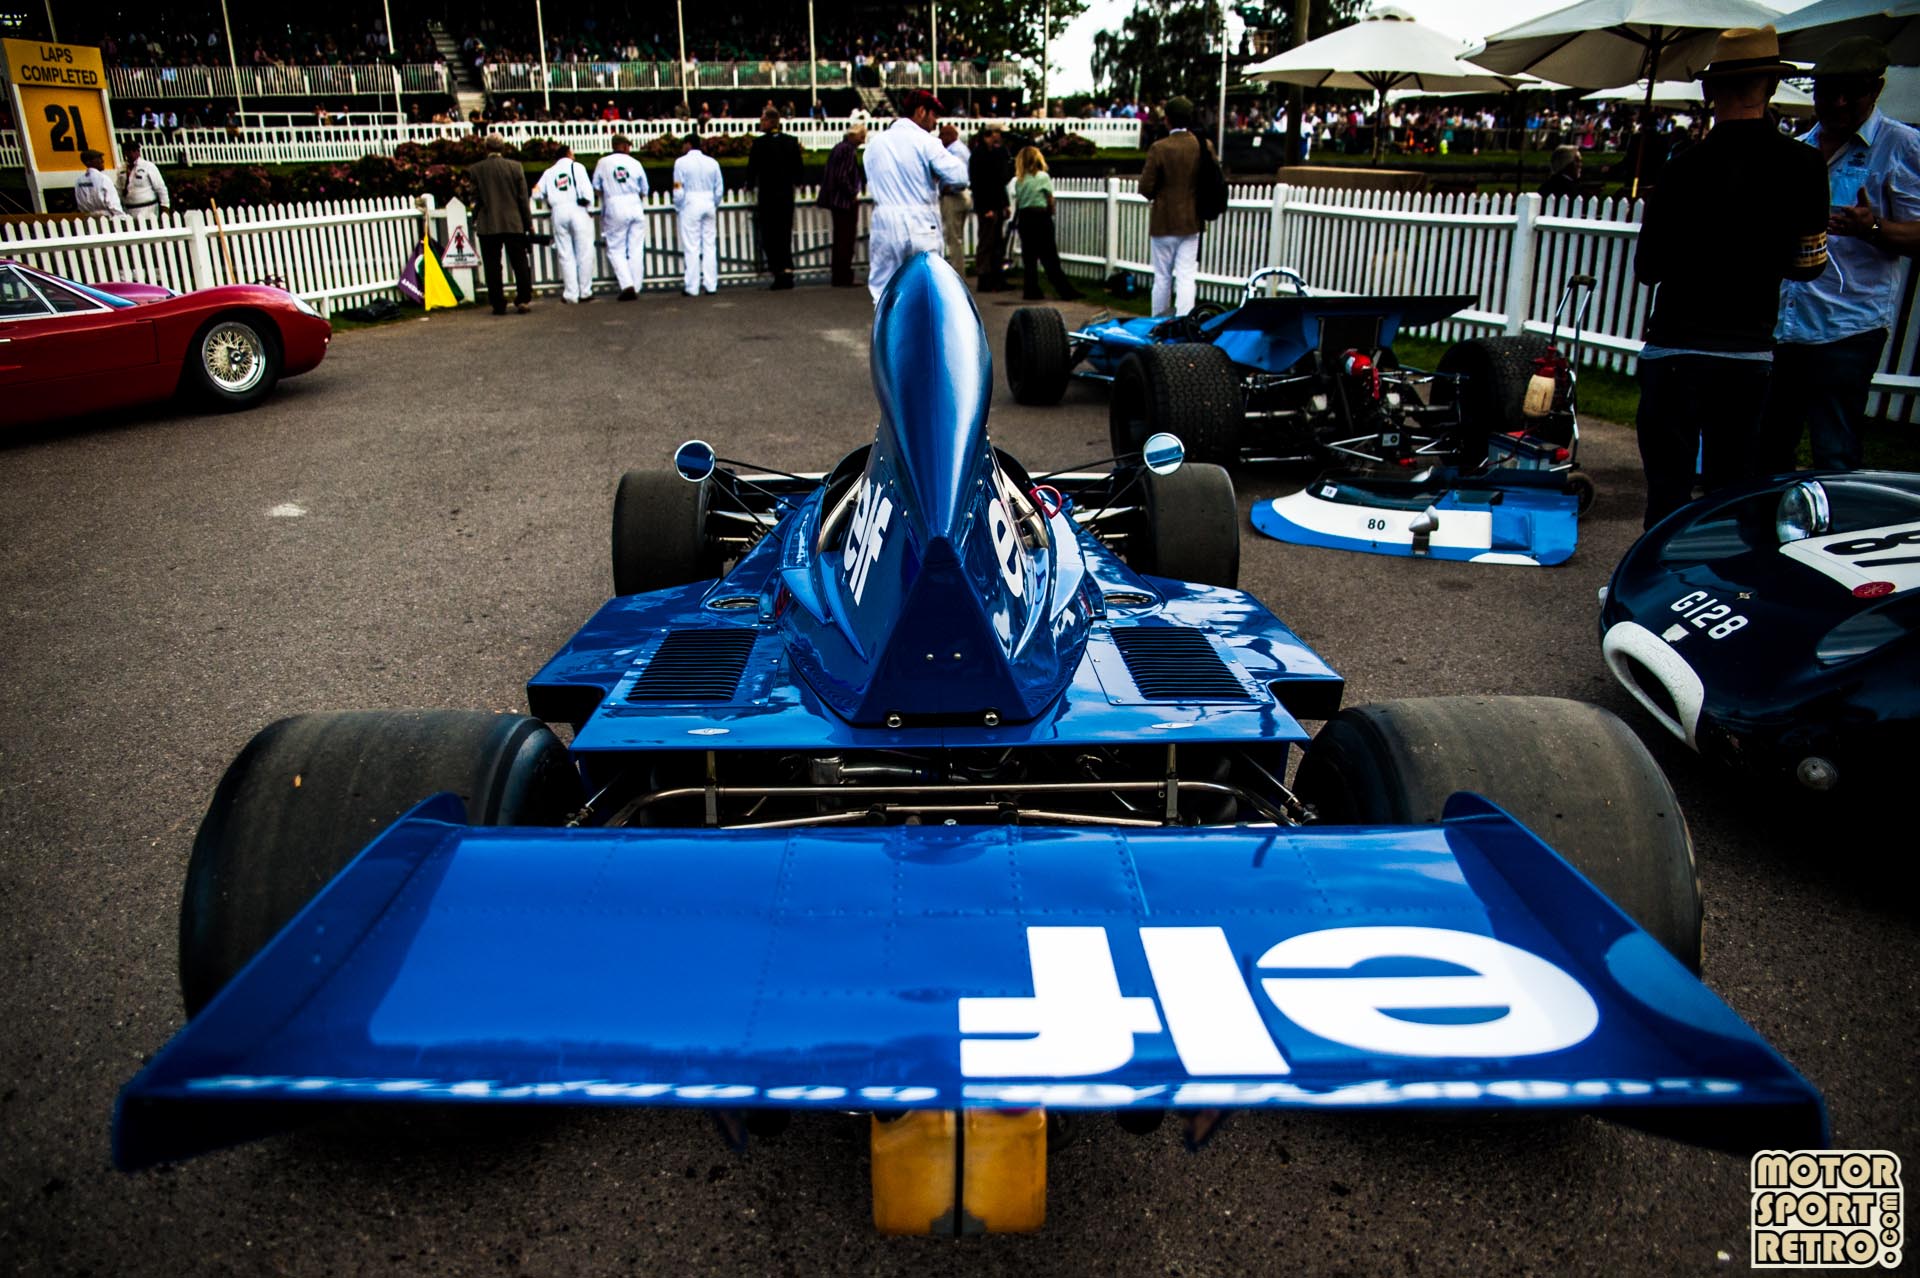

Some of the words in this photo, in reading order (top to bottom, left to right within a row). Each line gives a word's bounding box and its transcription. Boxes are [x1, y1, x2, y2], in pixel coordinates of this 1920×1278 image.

[39, 46, 73, 64] LAPS
[21, 65, 98, 85] COMPLETED
[44, 104, 89, 152] 21
[1367, 518, 1386, 531] 80
[1671, 591, 1748, 640] G128
[959, 927, 1599, 1078] elf
